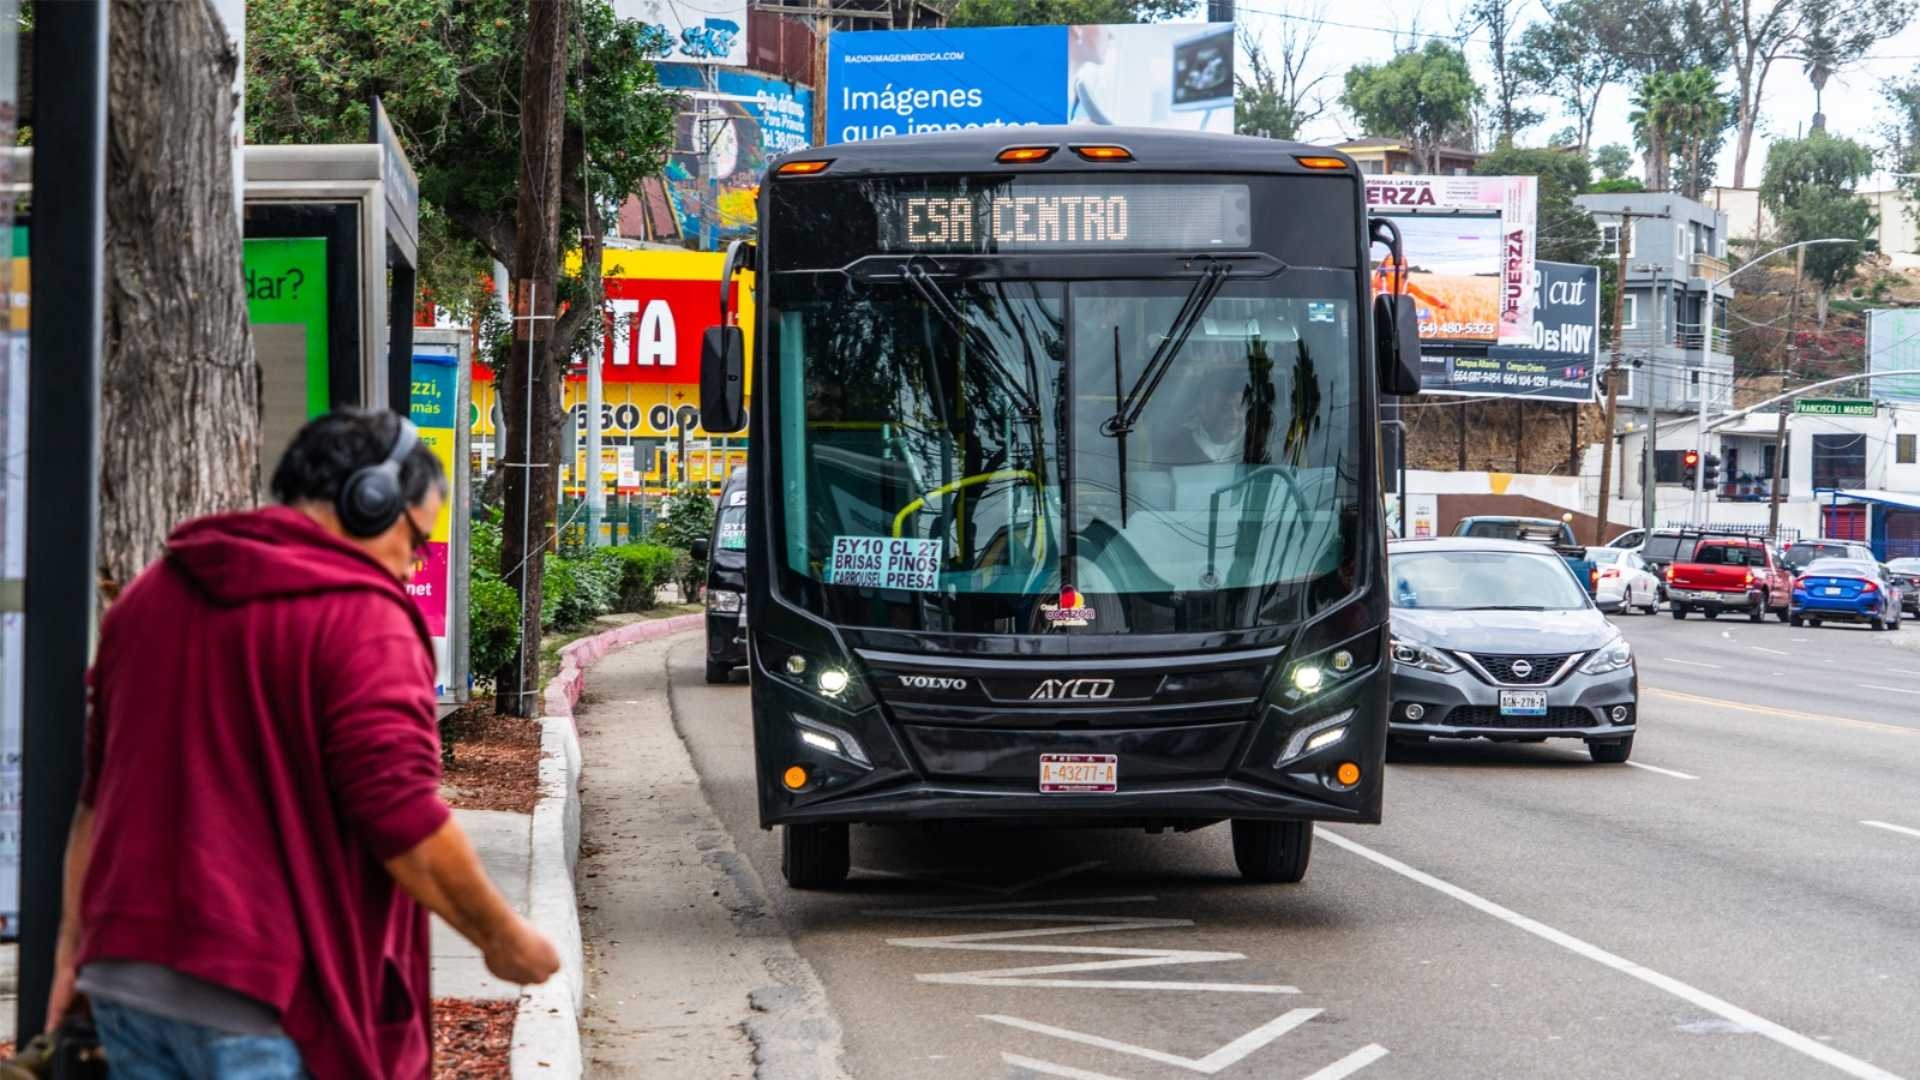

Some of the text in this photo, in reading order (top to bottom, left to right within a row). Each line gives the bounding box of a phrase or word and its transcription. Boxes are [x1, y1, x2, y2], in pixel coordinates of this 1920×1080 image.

[844, 52, 965, 63] RADIOIMAGENMEDICA.COM
[843, 83, 983, 115] Imágenes
[842, 124, 896, 143] que
[1366, 186, 1436, 206] ERZA
[908, 196, 1128, 242] ESA CENTRO
[1507, 229, 1524, 310] FUERZA
[245, 267, 305, 300] dar?
[1549, 276, 1587, 306] cut
[1561, 323, 1593, 354] HOY
[411, 400, 441, 414] más
[1797, 400, 1836, 413] FRANCISCO
[1843, 405, 1873, 415] MADERO
[890, 541, 912, 556] CL
[918, 541, 939, 557] 27
[835, 554, 937, 573] BRISAS PINOS
[887, 572, 936, 589] PRESA
[899, 675, 967, 690] VOLVO
[1029, 678, 1115, 700] AYCO
[1043, 764, 1114, 783] A-43277-A
